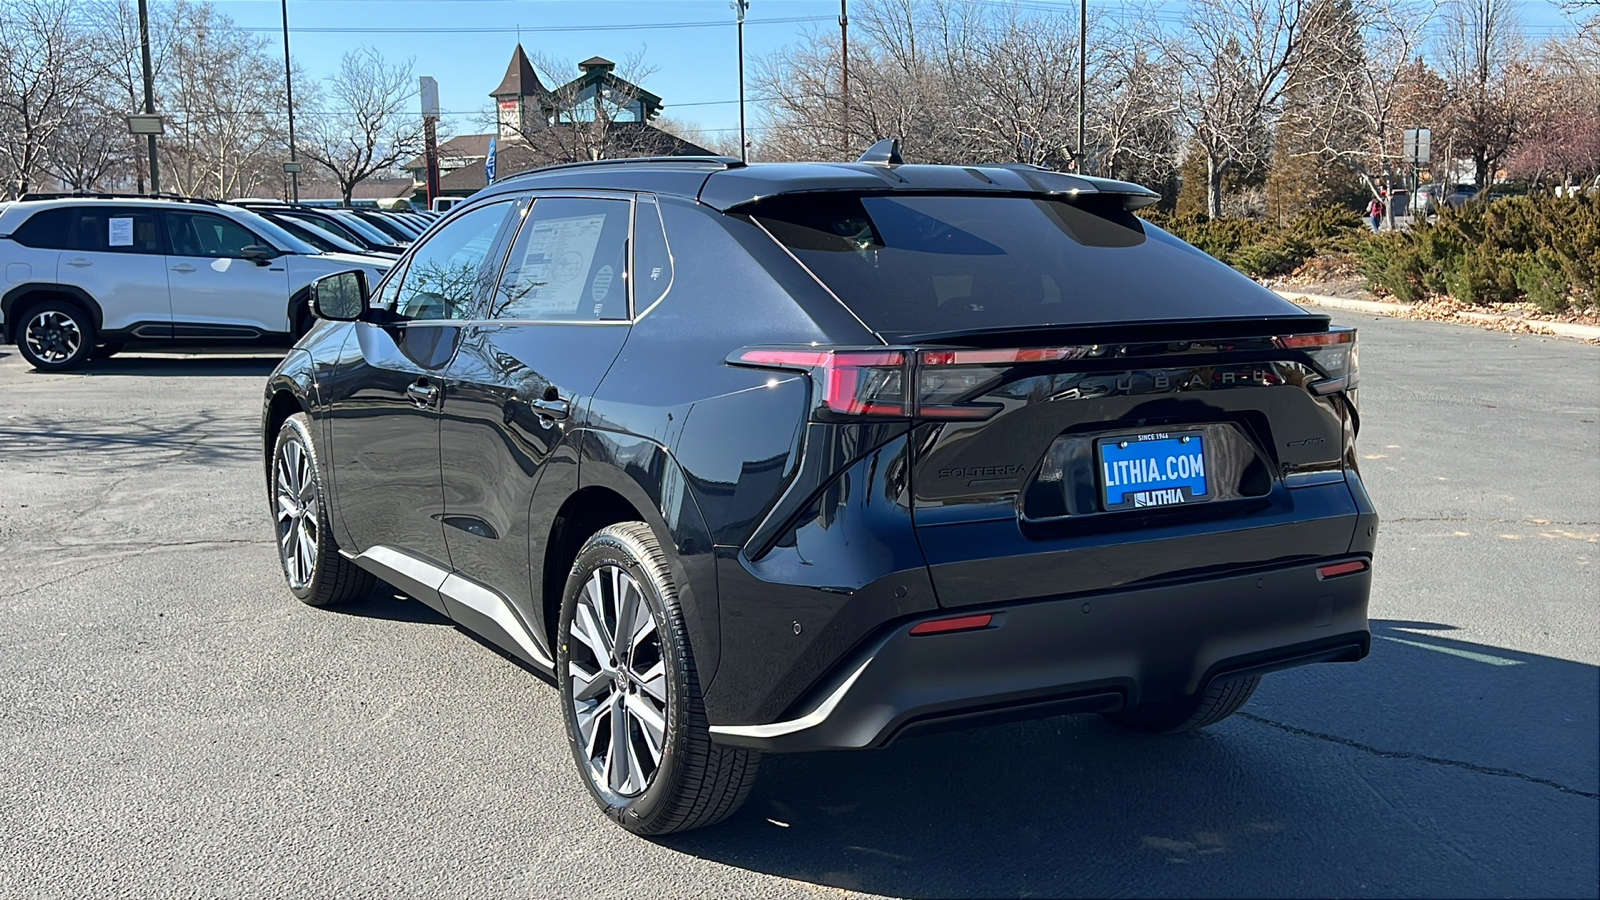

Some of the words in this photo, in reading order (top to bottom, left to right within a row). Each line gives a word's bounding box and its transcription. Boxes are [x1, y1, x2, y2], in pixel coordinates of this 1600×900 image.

[1078, 370, 1265, 393] SUBARU
[939, 464, 1026, 478] SOLTERRA
[1104, 453, 1205, 487] LITHIA.COM
[1145, 488, 1185, 506] LITHIA
